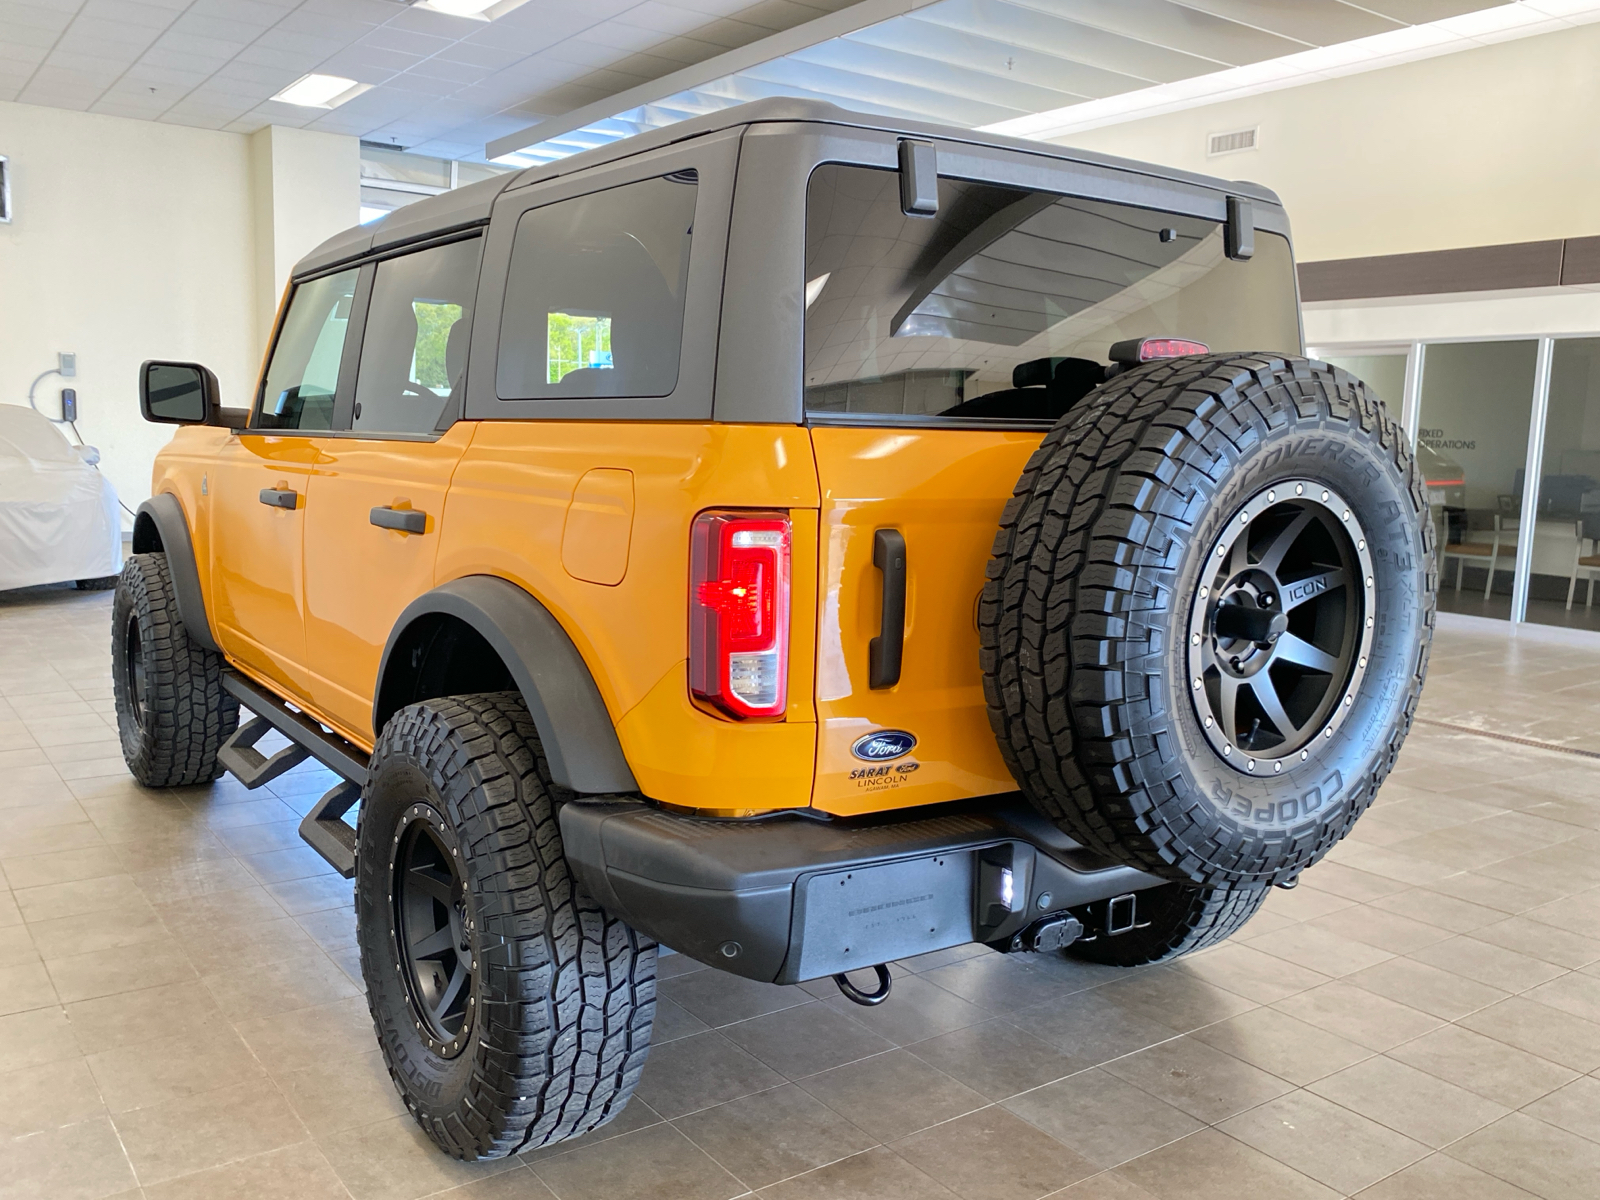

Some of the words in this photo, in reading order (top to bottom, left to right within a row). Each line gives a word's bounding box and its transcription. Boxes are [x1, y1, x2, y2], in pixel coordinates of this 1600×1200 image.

[1418, 429, 1443, 438] FIXED
[1418, 440, 1476, 450] OPERATIONS
[1200, 437, 1381, 548] DISCOVERER
[1289, 576, 1328, 602] ICON
[867, 737, 903, 757] Ford
[848, 764, 893, 780] SARAT
[857, 775, 908, 788] LINCOLN
[1211, 769, 1343, 823] COOPER
